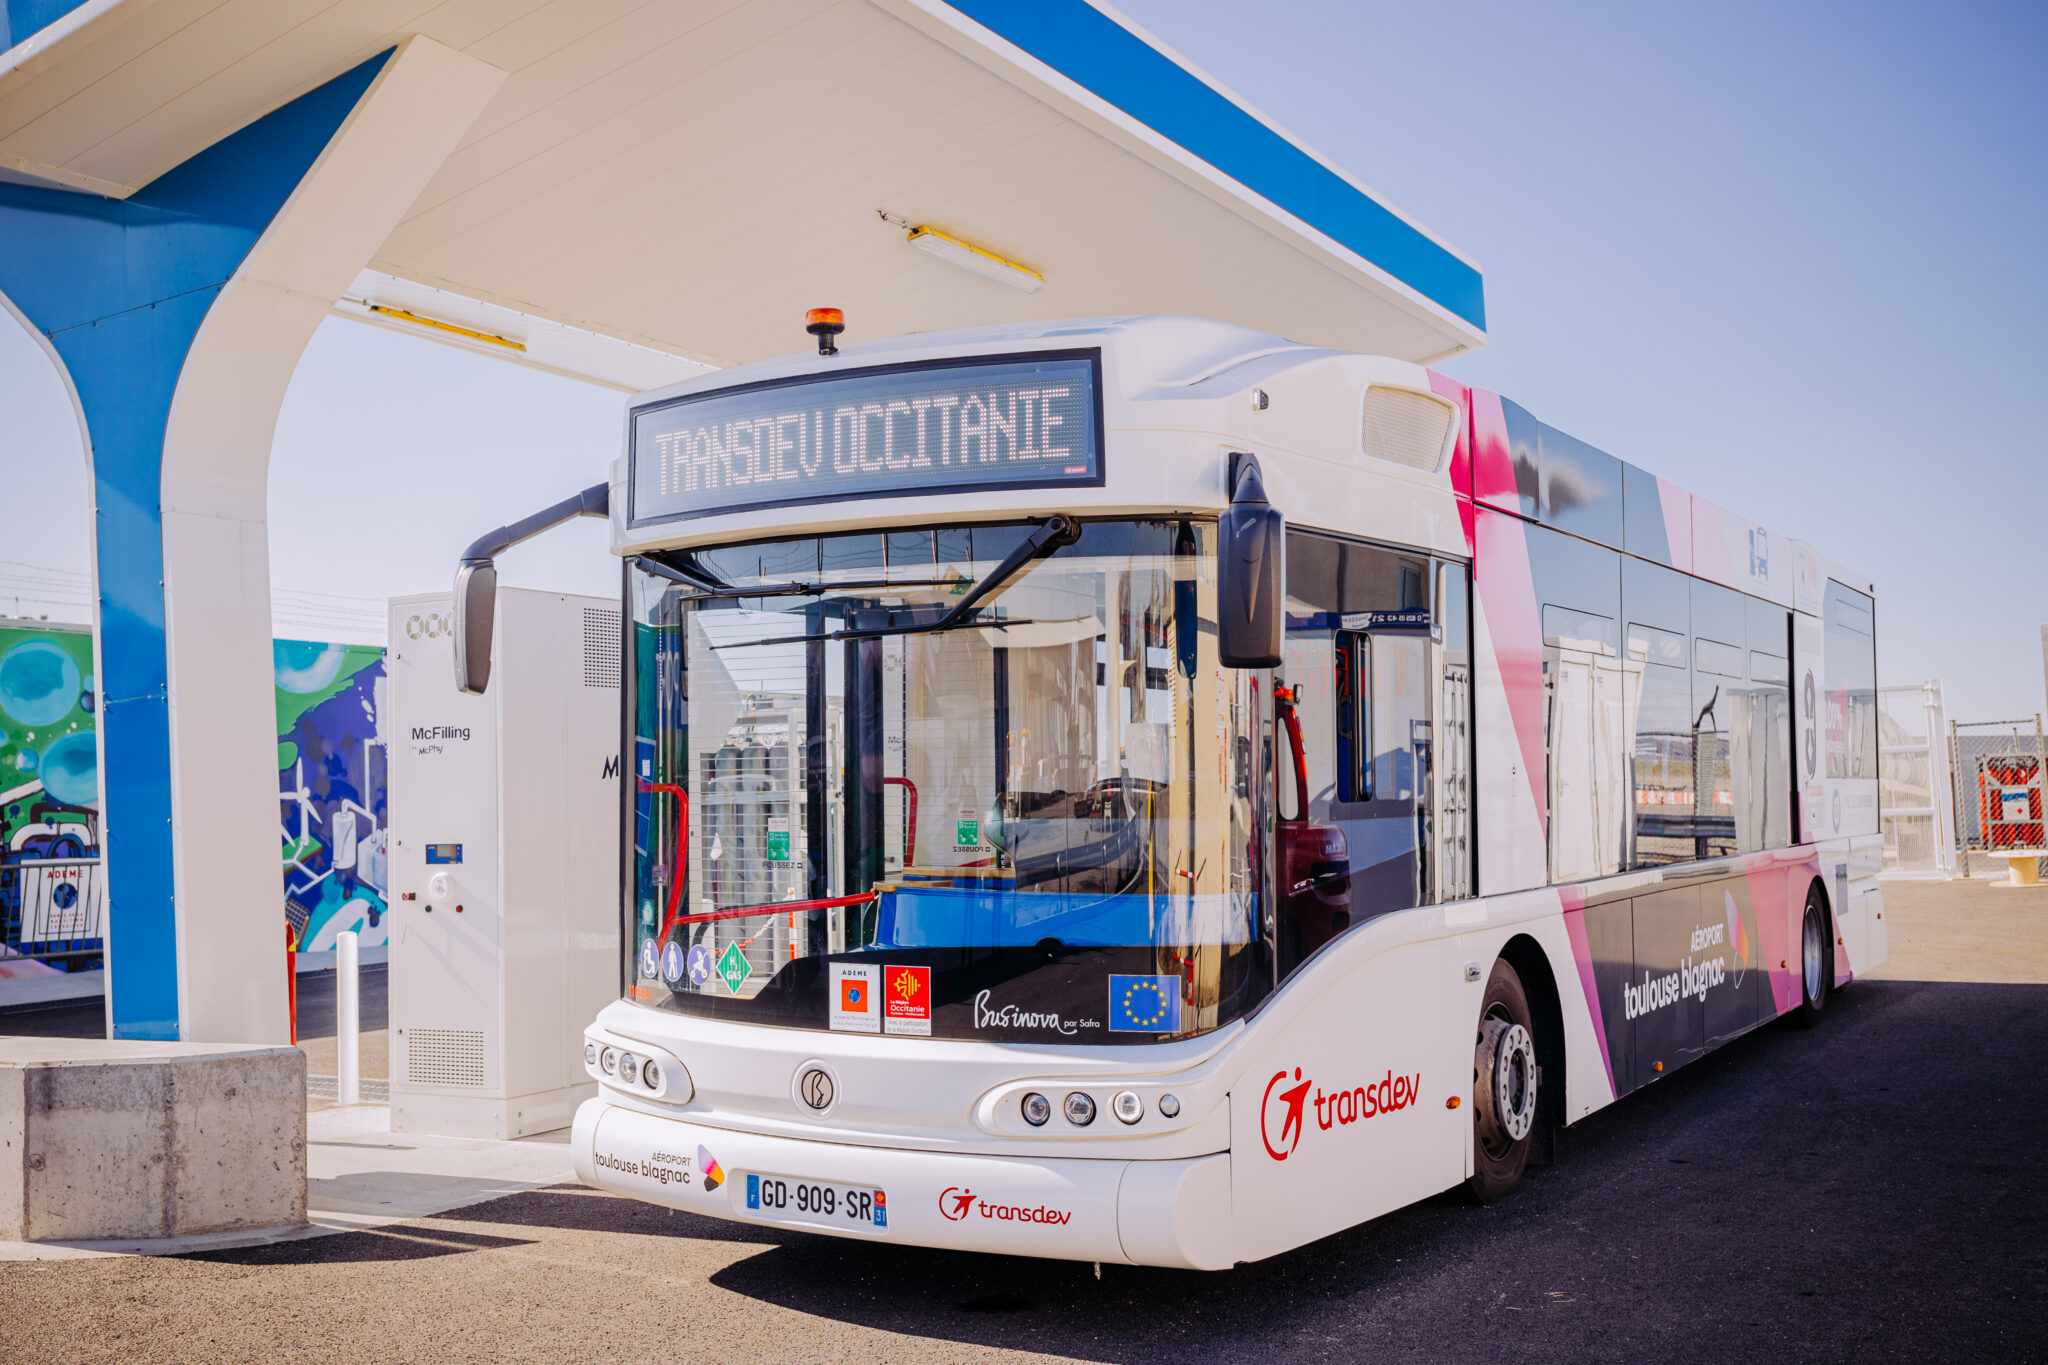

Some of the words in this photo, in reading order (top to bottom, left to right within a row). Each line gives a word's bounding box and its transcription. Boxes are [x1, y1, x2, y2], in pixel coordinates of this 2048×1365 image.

[655, 410, 823, 496] TRANSDEV
[834, 387, 1071, 475] OCCITANIE
[412, 726, 471, 741] McFilling
[418, 745, 443, 756] McPhy
[762, 861, 795, 869] POUSSEZ
[47, 869, 84, 879] ADEME
[1690, 923, 1724, 953] AÉROPORT
[726, 970, 742, 981] GAS
[1624, 970, 1680, 1021] toulouse
[1681, 956, 1726, 1003] blagnac
[890, 1005, 925, 1013] Occitanie
[974, 989, 1078, 1035] Businova
[1064, 1020, 1078, 1029] par
[1079, 1019, 1101, 1028] Safra
[1314, 1070, 1421, 1131] transdev
[651, 1152, 692, 1167] AÉROPORT
[595, 1151, 639, 1175] toulouse
[641, 1165, 691, 1185] blagnac
[875, 1209, 886, 1223] 31
[978, 1199, 1072, 1226] transdev
